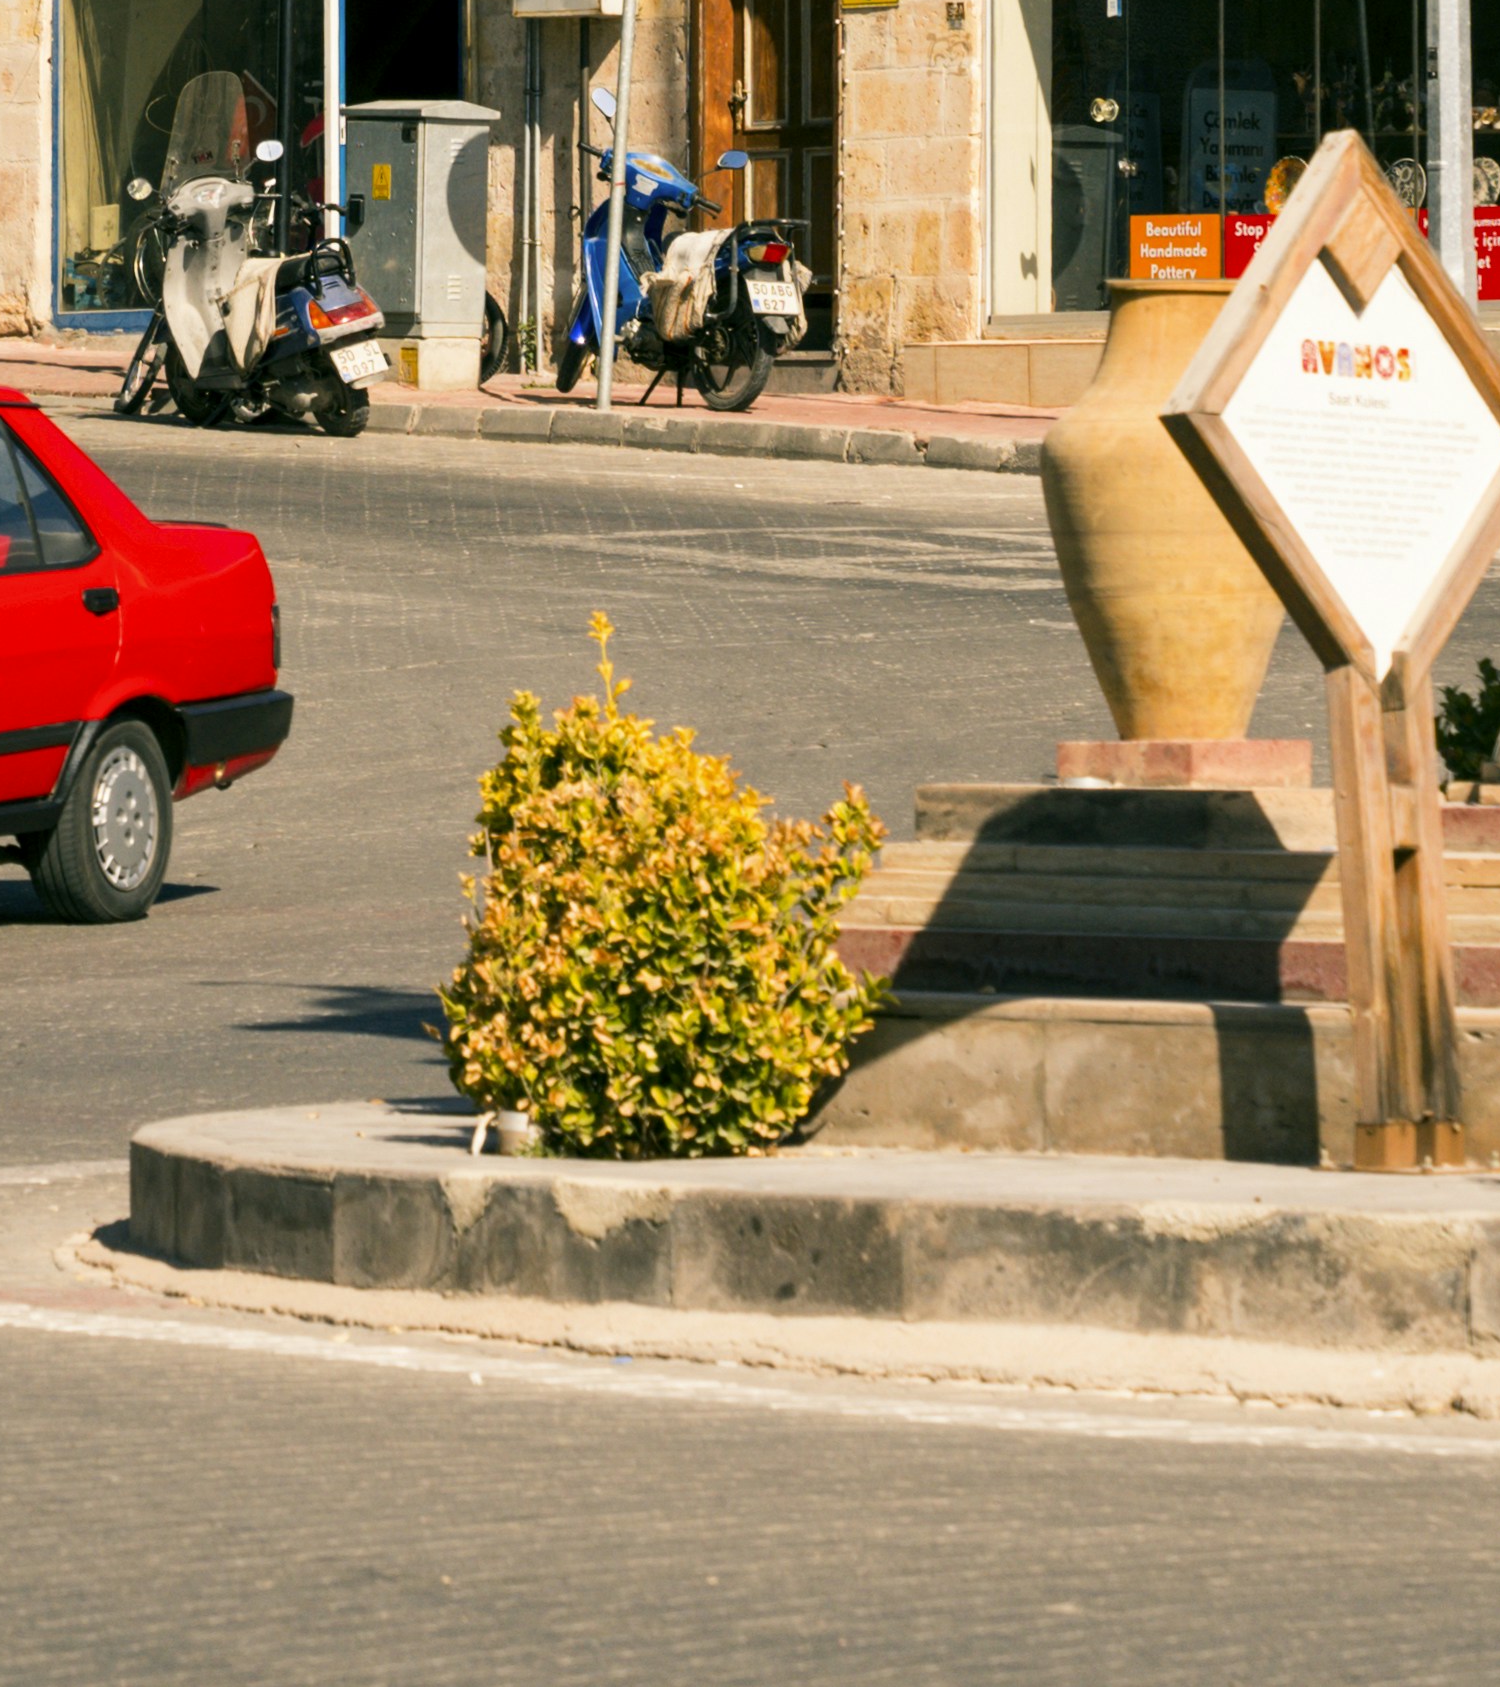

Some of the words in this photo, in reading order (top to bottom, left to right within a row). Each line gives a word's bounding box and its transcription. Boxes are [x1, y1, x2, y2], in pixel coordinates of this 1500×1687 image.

[1200, 137, 1264, 157] Yaımını
[1145, 221, 1202, 237] Beautiful
[1234, 221, 1264, 240] Stop
[1140, 242, 1208, 258] Handmade
[1150, 263, 1197, 279] Pottery
[752, 283, 768, 296] 50
[763, 298, 786, 311] 627
[337, 348, 356, 365] 50
[1301, 338, 1412, 382] AVANOS
